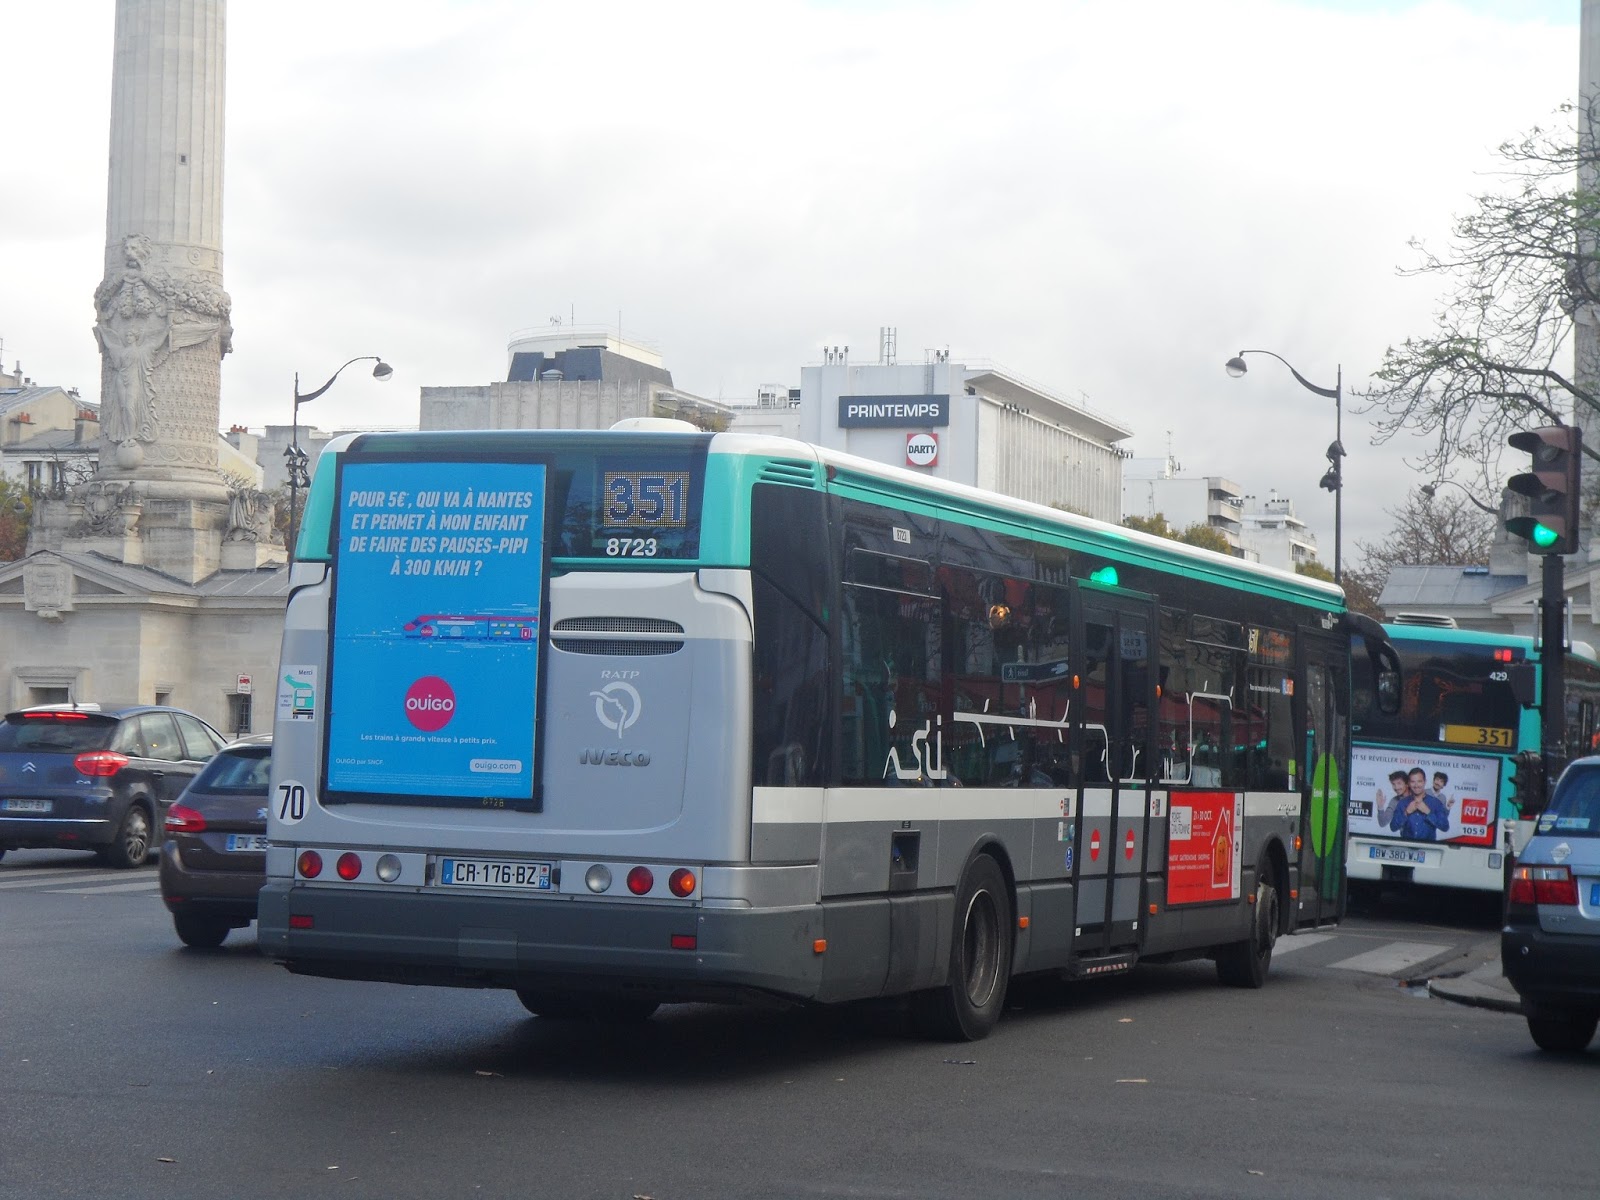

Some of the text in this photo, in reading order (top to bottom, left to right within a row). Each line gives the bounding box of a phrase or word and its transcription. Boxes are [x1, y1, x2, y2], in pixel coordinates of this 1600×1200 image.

[848, 404, 940, 418] PRINTEMPS
[908, 445, 936, 454] DARTY
[348, 491, 386, 508] POUR
[416, 491, 441, 508] QUI
[443, 492, 460, 508] VA
[463, 486, 474, 508] À
[476, 492, 533, 508] NANTES
[607, 476, 684, 523] 351
[352, 510, 528, 531] ET PERMET À MON ENFANT
[350, 536, 529, 554] DE FAIRE DES PAUSES-PIPI
[606, 538, 658, 557] 8723
[390, 554, 483, 577] À 300 KM/H ?
[600, 670, 640, 679] RATP
[401, 735, 426, 743] grande
[459, 736, 480, 745] petits
[482, 737, 497, 745] prix.
[1478, 728, 1510, 746] 351
[474, 762, 516, 771] ouigo.com
[580, 748, 650, 767] IVECO
[278, 784, 304, 820] 70
[1464, 806, 1486, 817] RTL2
[455, 863, 548, 886] CR-176-BZ 75
